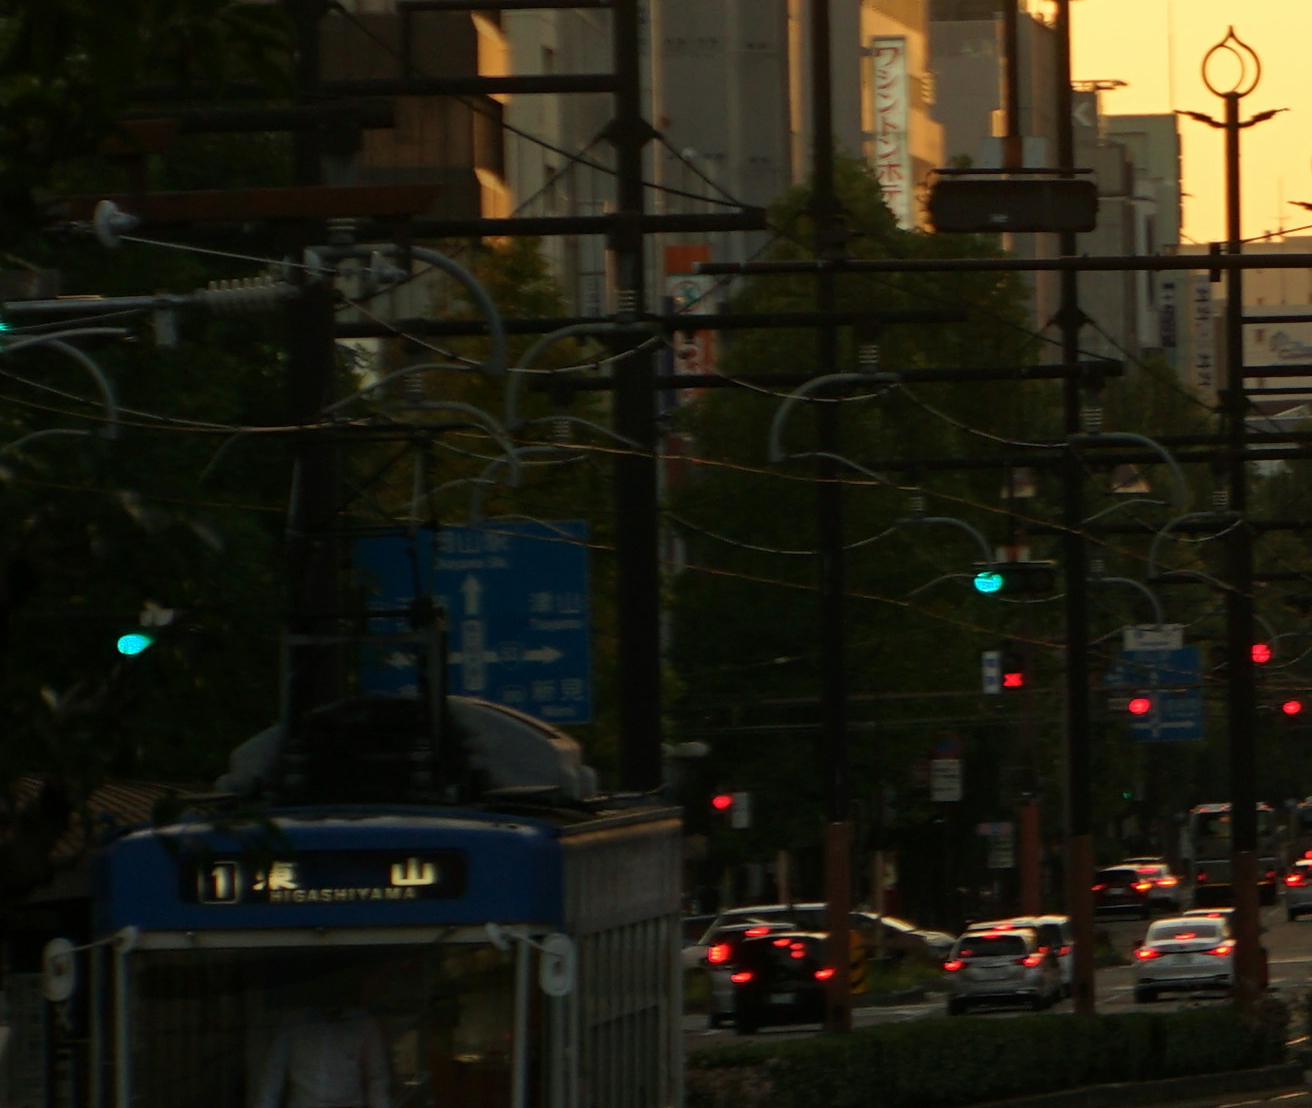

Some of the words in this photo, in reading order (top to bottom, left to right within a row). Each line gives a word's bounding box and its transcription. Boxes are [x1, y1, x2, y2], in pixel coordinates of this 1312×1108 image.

[877, 46, 903, 206] ワシントンホテ
[210, 864, 230, 900] 1
[268, 886, 418, 903] HIGASHIYAMA
